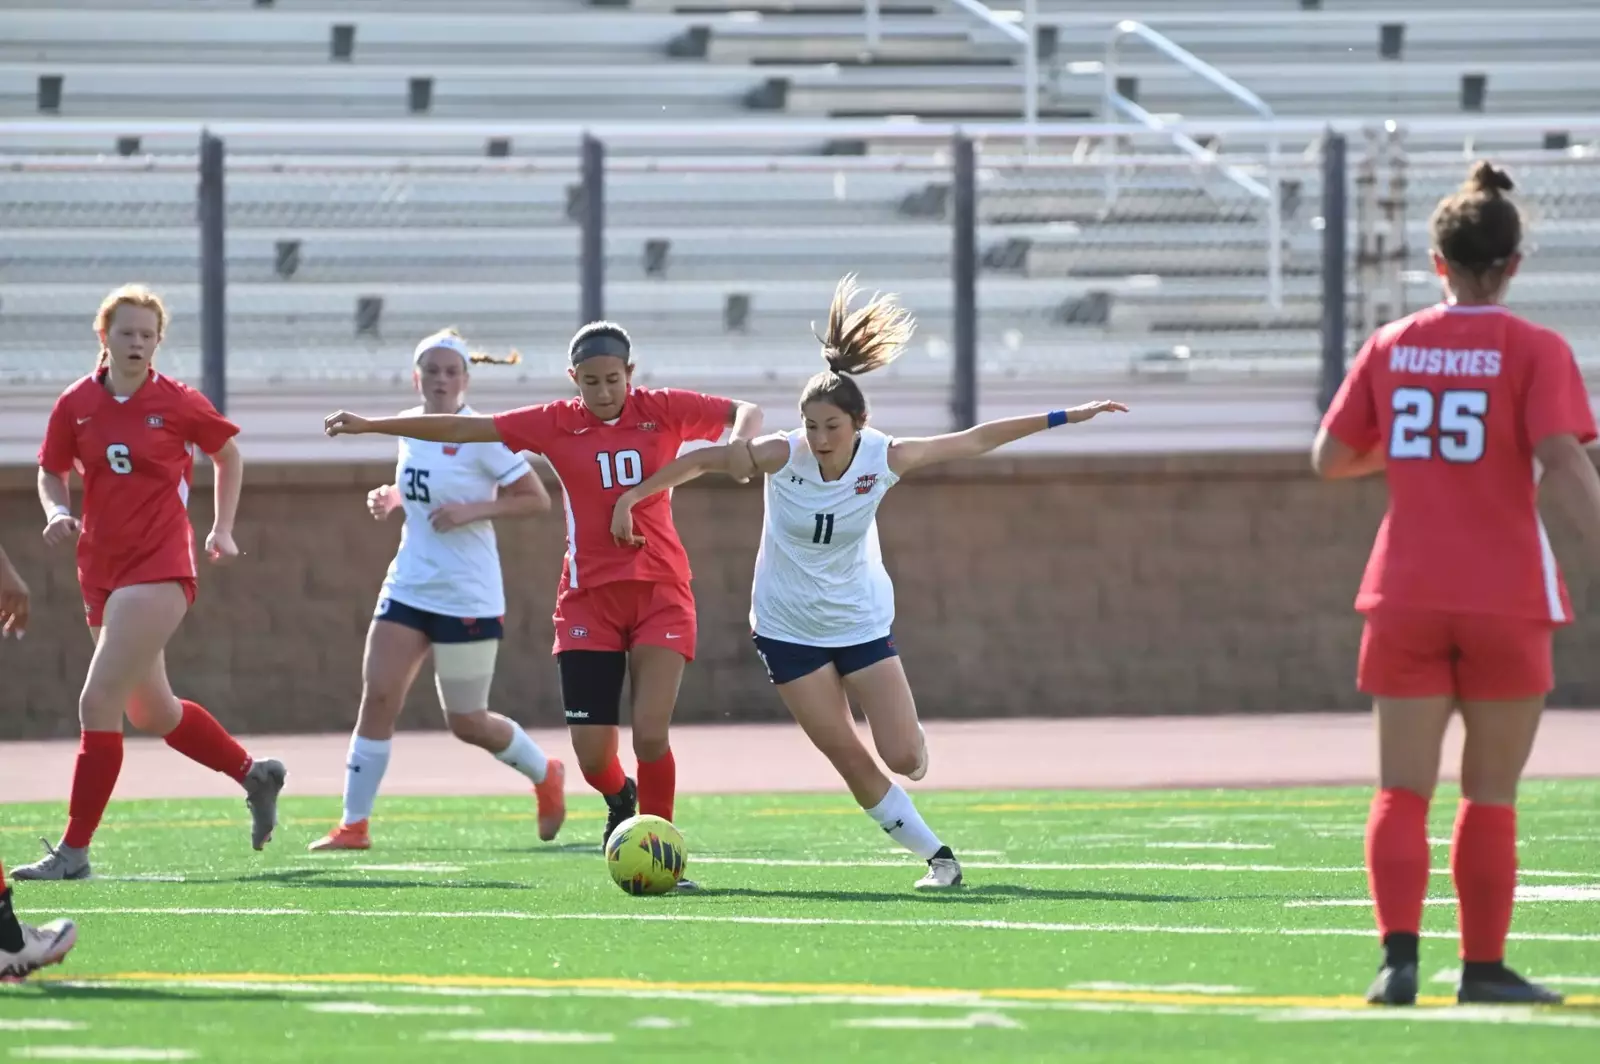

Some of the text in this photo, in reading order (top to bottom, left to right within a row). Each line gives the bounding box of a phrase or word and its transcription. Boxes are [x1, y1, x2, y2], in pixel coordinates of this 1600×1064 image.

[1390, 346, 1501, 376] HUSKIES
[1389, 386, 1488, 464] 25
[106, 443, 132, 475] 6
[595, 449, 643, 489] 10
[405, 467, 430, 503] 35
[813, 513, 834, 544] 11
